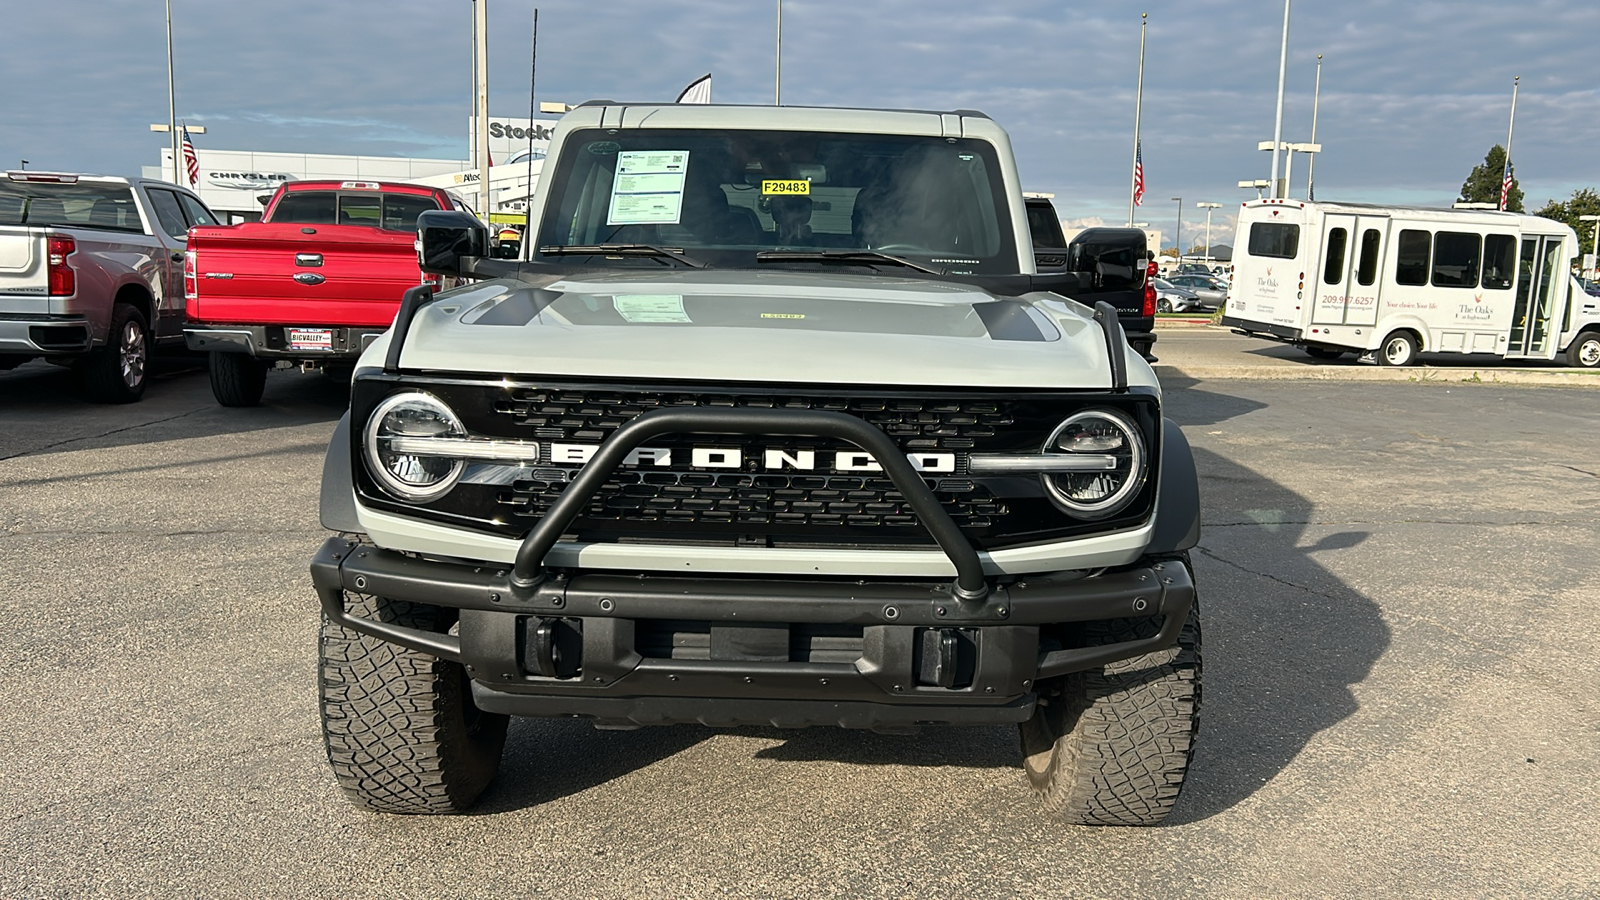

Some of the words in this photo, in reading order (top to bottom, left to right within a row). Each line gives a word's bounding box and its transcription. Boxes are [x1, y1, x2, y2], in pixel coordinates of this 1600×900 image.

[209, 172, 287, 181] CHRYSLER
[764, 182, 807, 192] F29483
[1459, 304, 1473, 313] The
[1474, 305, 1494, 314] Oaks
[551, 443, 955, 473] BRONCO
